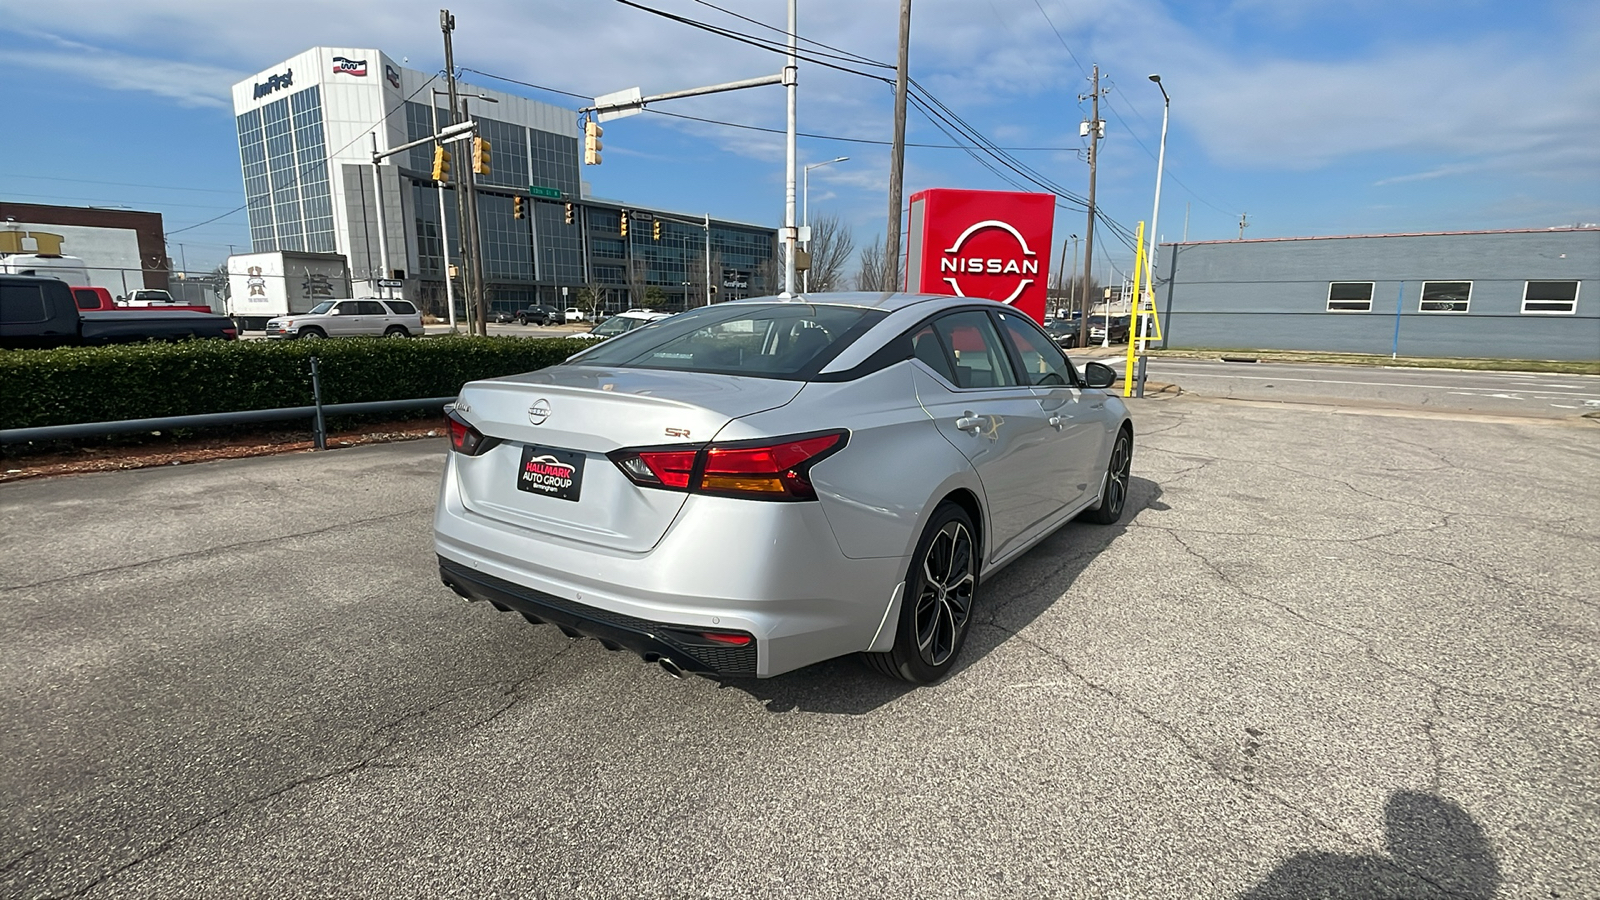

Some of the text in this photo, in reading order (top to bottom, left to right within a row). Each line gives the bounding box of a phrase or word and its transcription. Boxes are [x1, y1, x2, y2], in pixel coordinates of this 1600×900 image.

[253, 68, 293, 100] AmFirst
[941, 257, 1038, 274] NISSAN
[665, 427, 691, 439] SR
[526, 462, 571, 479] HALLMARK
[523, 471, 573, 489] AUTO GROUP
[533, 482, 559, 492] Birmingham
